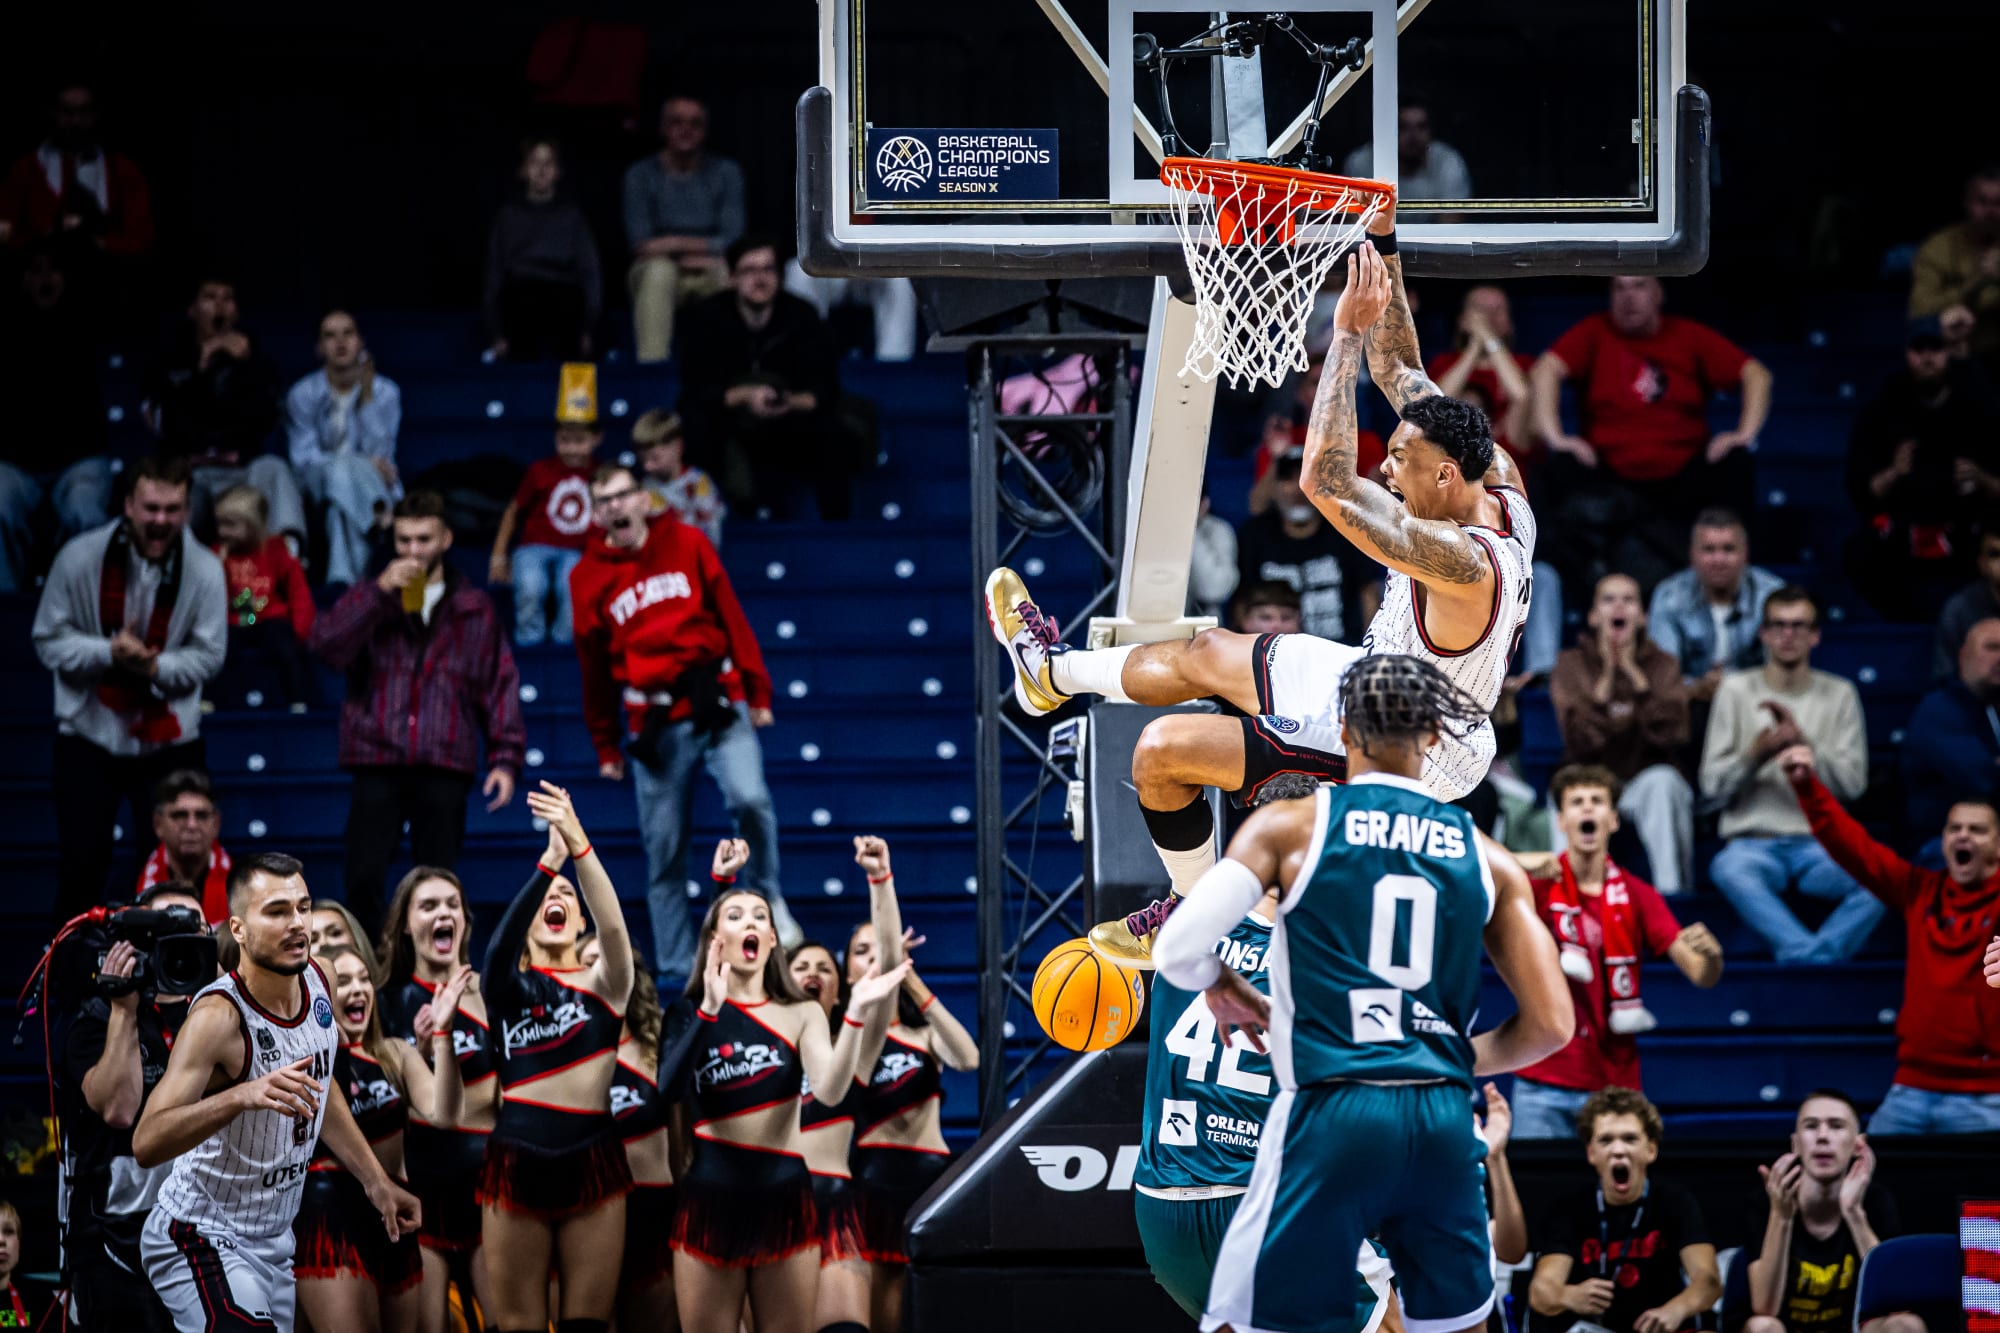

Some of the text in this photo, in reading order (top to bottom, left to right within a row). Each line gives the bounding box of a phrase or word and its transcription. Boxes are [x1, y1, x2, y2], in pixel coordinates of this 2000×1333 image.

[938, 136, 1038, 148] BASKETBALL
[938, 149, 1050, 164] CHAMPIONS
[938, 166, 998, 178] LEAGUE
[938, 182, 999, 193] SEASON X
[1345, 810, 1467, 859] GRAVES
[1368, 873, 1438, 991] 0
[1206, 1113, 1260, 1137] ORLEN
[1205, 1130, 1261, 1149] TERMIKA
